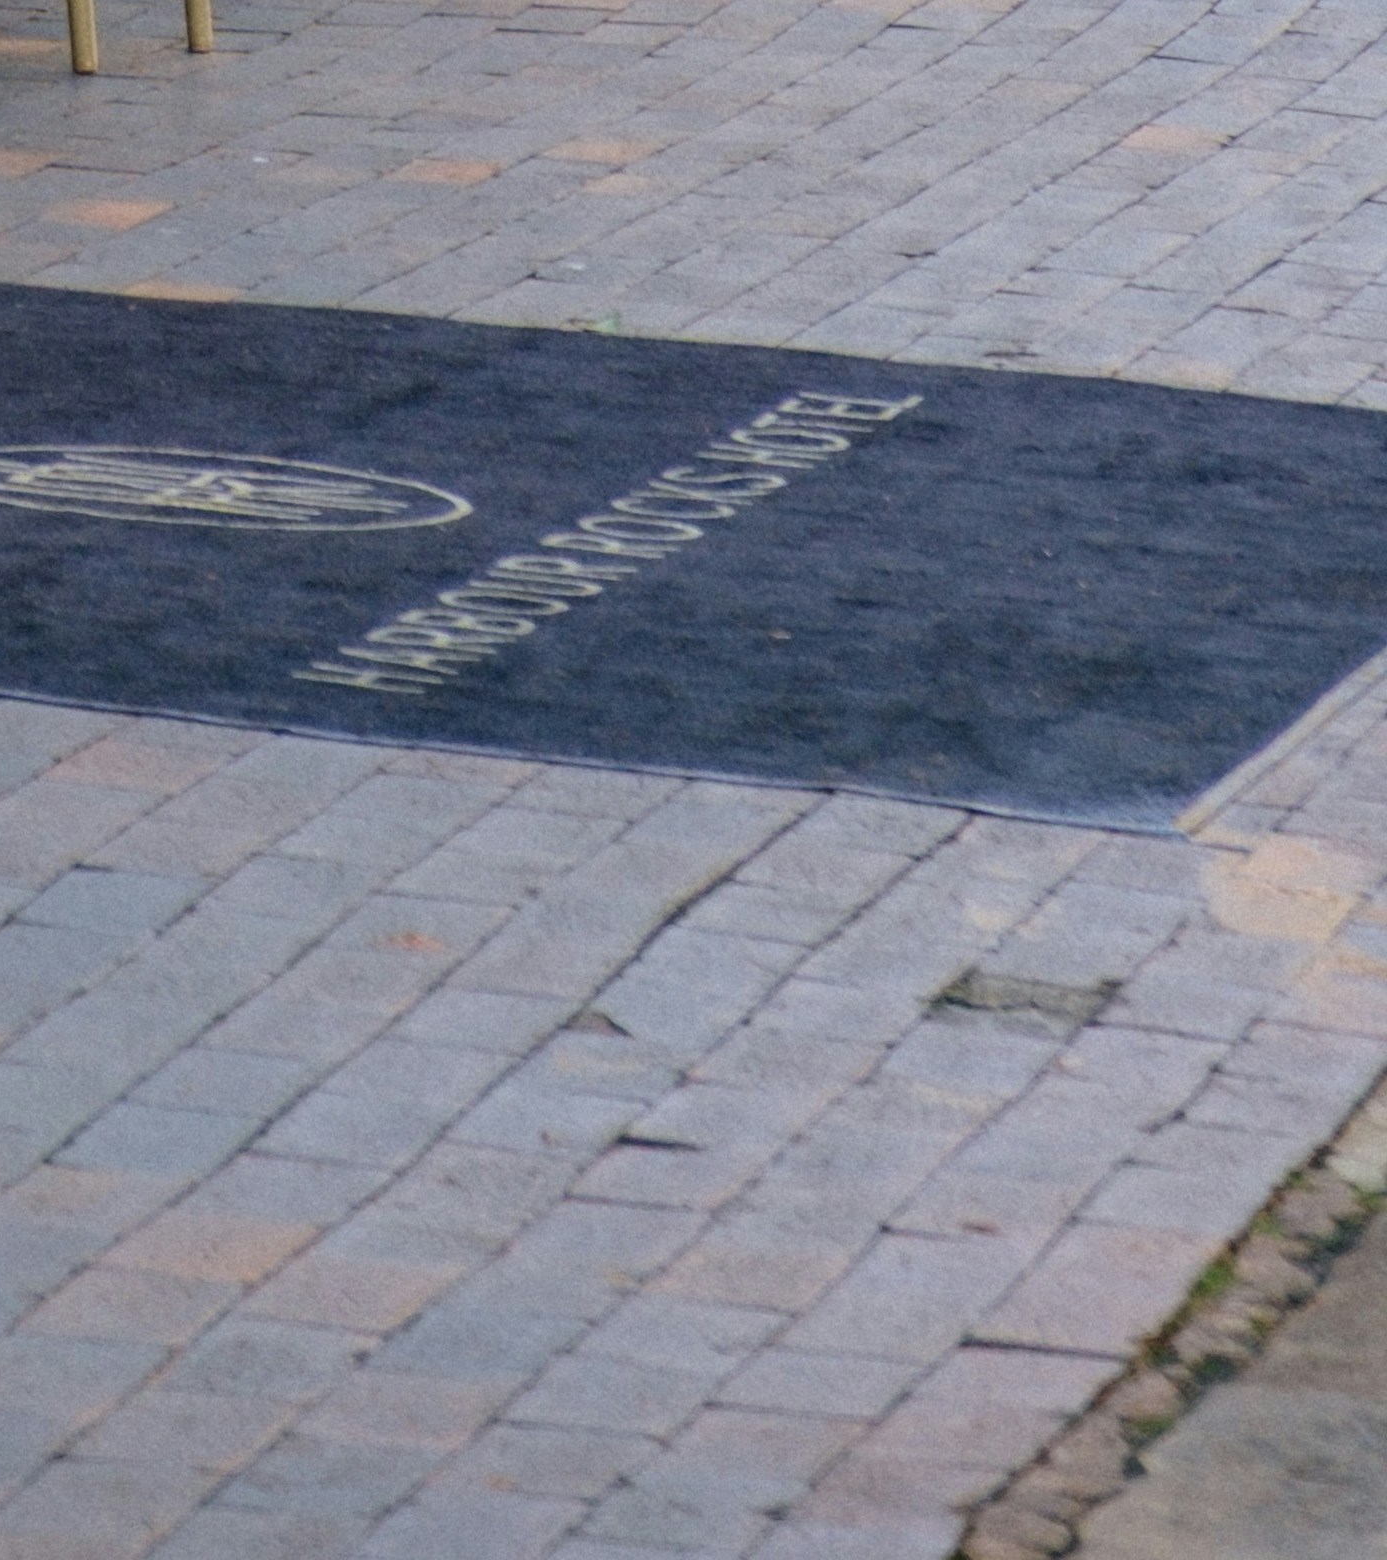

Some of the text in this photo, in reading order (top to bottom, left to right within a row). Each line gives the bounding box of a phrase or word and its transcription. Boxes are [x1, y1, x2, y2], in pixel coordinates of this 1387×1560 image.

[292, 391, 924, 694] HARBOUR ROCKS HOTEL
